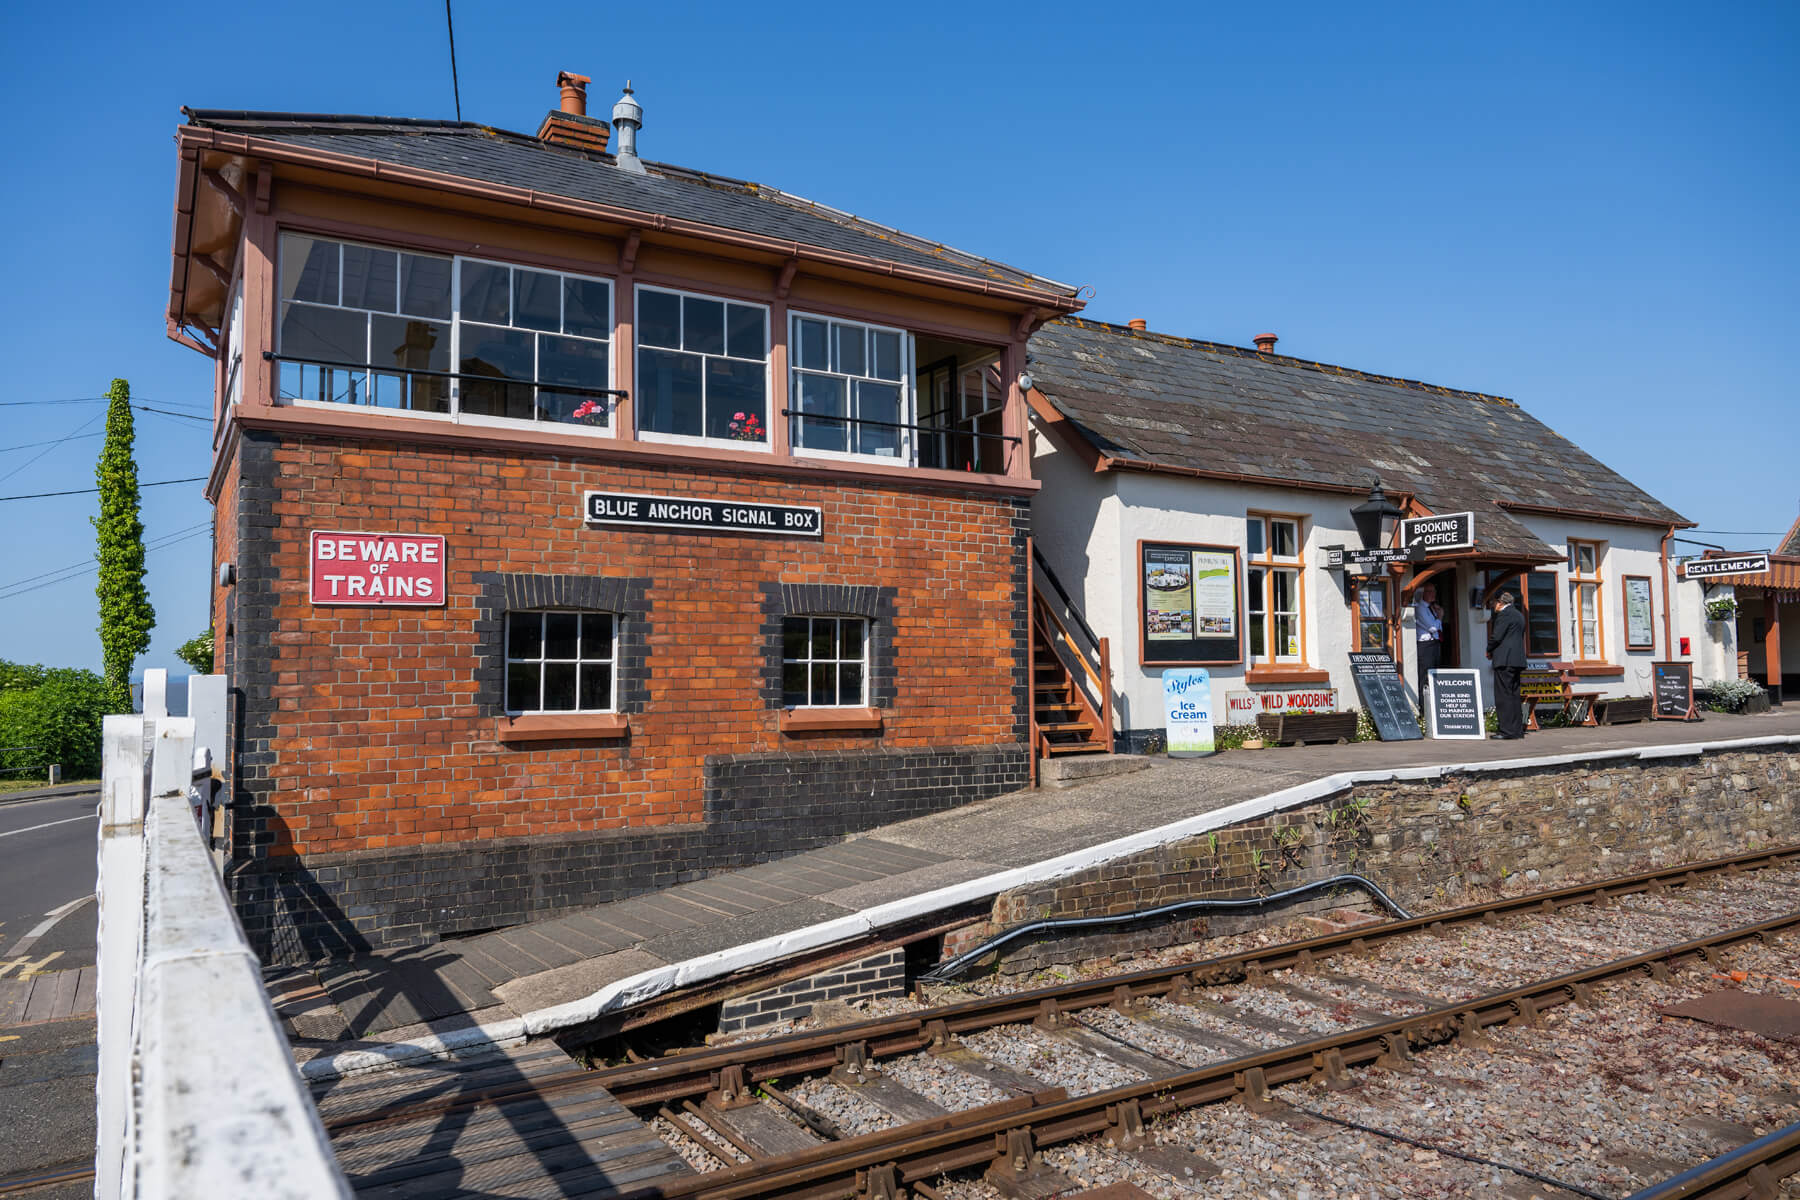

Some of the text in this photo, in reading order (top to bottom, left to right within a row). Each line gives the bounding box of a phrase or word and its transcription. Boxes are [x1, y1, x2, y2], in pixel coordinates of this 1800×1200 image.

[594, 499, 814, 528] BLUE ANCHOR SIGNAL BOX
[1414, 520, 1458, 535] BOOKING
[1424, 532, 1458, 545] OFFICE
[317, 539, 439, 563] BEWARE
[369, 563, 389, 575] OF
[1688, 561, 1751, 574] GENTLEMEN
[323, 575, 433, 597] TRAINS
[1352, 654, 1391, 662] DEPARTURES
[1167, 674, 1204, 695] Styles
[1180, 700, 1196, 711] Ice
[1170, 710, 1207, 720] Cream
